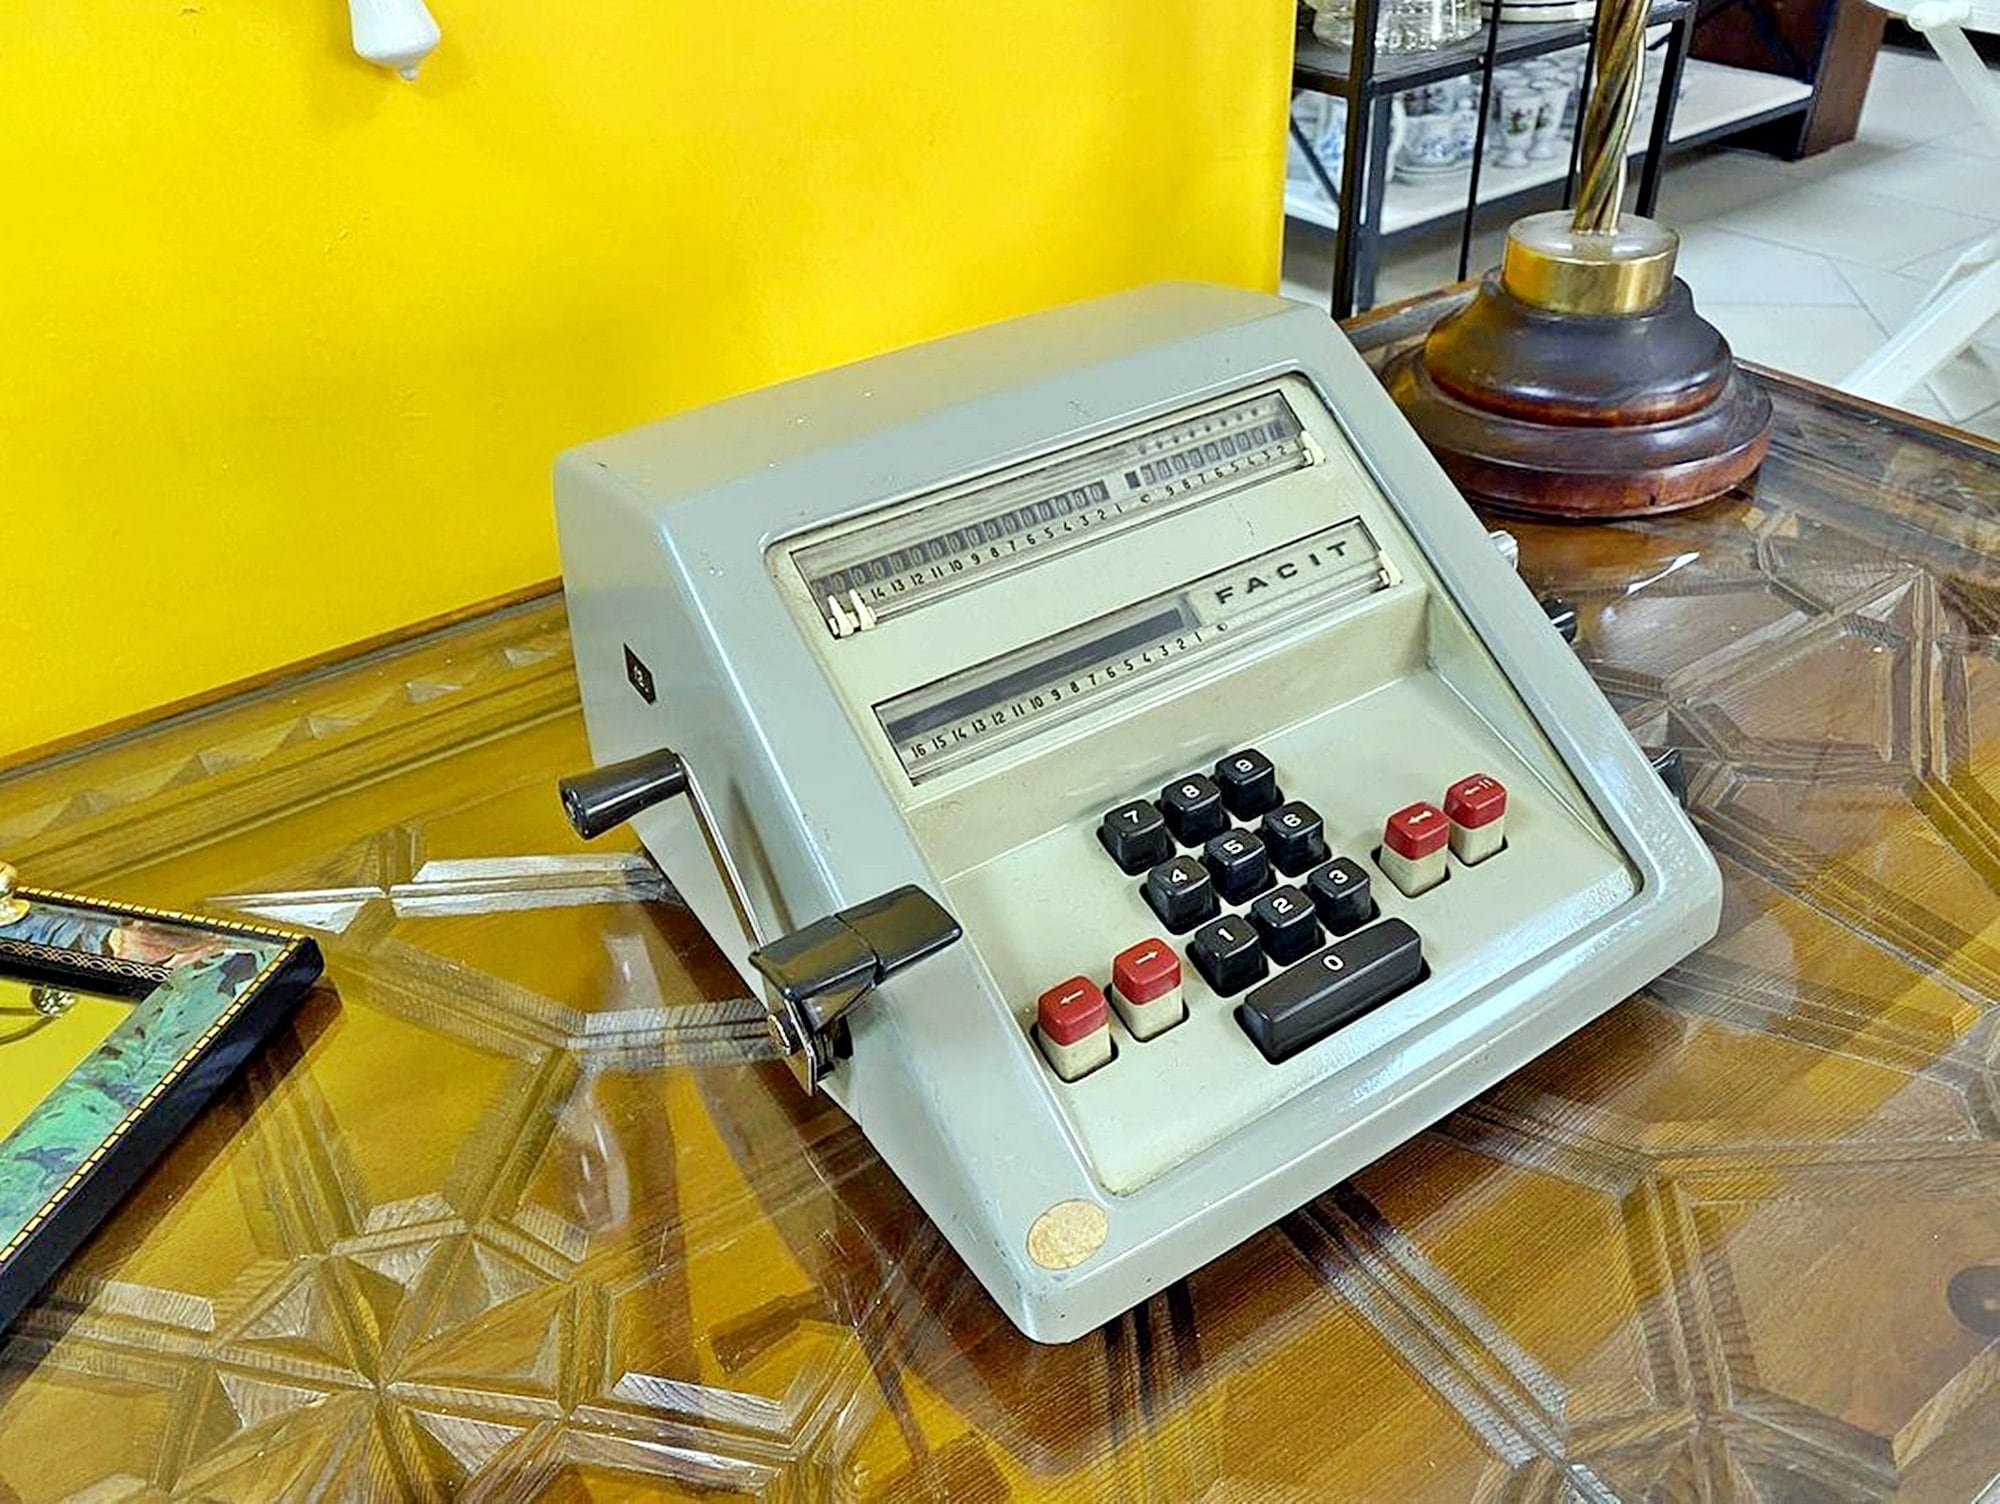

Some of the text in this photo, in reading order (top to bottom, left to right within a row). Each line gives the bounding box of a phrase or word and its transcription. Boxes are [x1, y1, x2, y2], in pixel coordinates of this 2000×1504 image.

[871, 587, 886, 600] 14
[890, 578, 905, 592] 13
[910, 572, 925, 586] 12
[930, 565, 944, 579] 11
[948, 559, 963, 573] 10
[1214, 540, 1347, 604] FACIT
[911, 743, 926, 758] 16
[932, 734, 947, 750] 15
[952, 727, 967, 742] 14
[971, 719, 986, 733] 13
[991, 711, 1006, 726] 12
[1011, 703, 1025, 717] 11
[1029, 695, 1044, 710] 10
[1235, 758, 1254, 773] 9
[1181, 784, 1201, 798] 8
[1122, 809, 1139, 824] 7
[1282, 813, 1302, 828] 6
[1222, 839, 1244, 855] 5
[1171, 869, 1188, 884] 4
[1328, 869, 1349, 884] 3
[1272, 897, 1294, 914] 2
[1217, 927, 1234, 942] 1
[1322, 954, 1345, 971] 0
